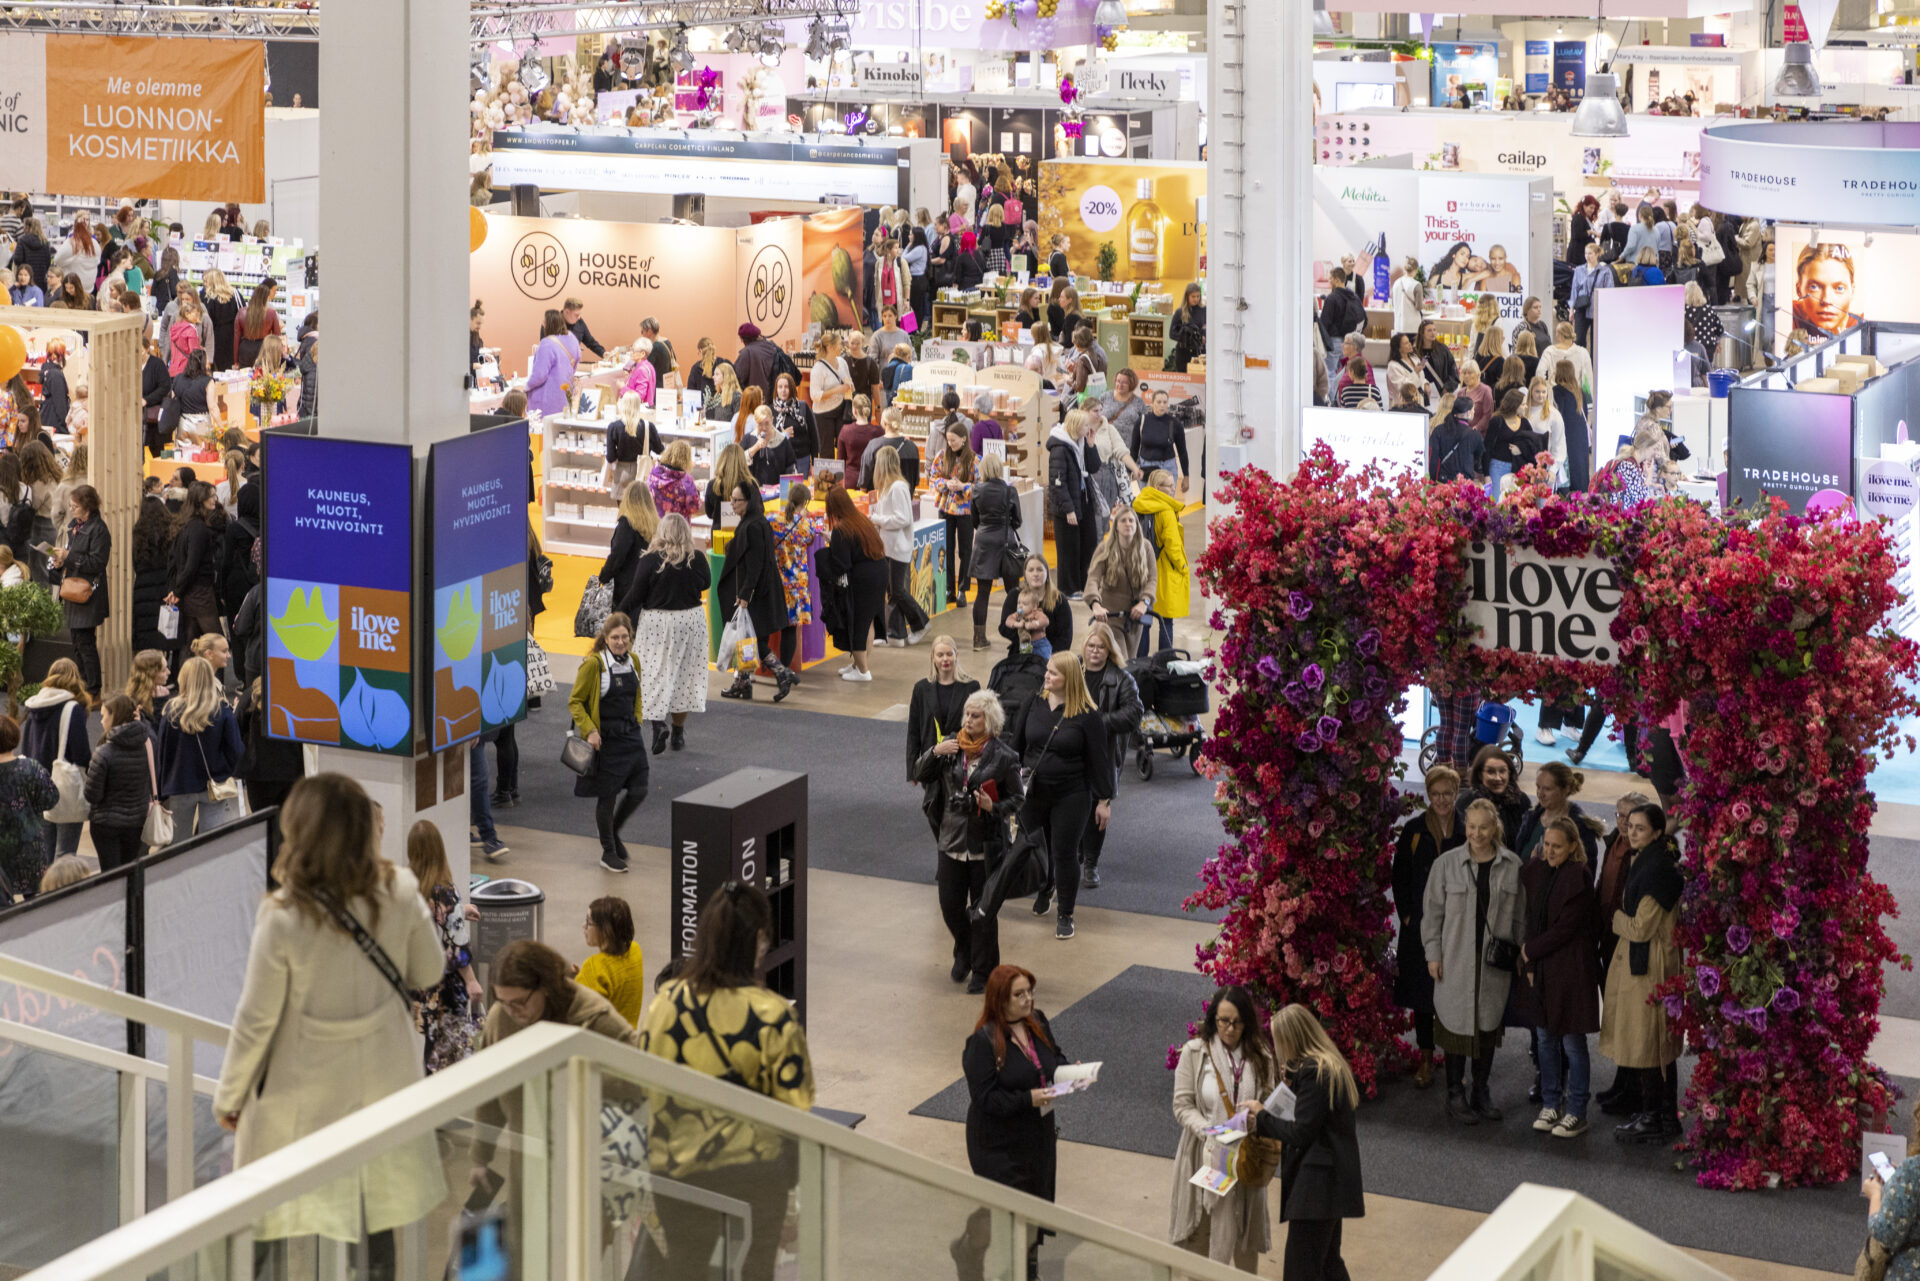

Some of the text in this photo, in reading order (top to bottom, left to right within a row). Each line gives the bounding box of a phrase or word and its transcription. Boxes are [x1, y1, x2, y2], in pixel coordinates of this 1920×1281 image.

[843, 0, 972, 32] wistbe
[863, 67, 920, 82] Kinoko
[106, 76, 202, 97] Me olemme
[4, 91, 22, 112] of
[83, 103, 223, 133] LUONNON-
[69, 132, 241, 165] KOSMETIIKKA
[634, 142, 735, 153] CARPELAN COSMETICS FINLAND
[1497, 150, 1547, 168] cailap
[1730, 169, 1797, 187] TRADEHOUSE
[1842, 179, 1920, 191] TRADEHOU
[1084, 201, 1118, 216] -20%
[1424, 215, 1460, 229] This is
[1424, 229, 1476, 243] your skin
[579, 252, 655, 273] HOUSE of
[578, 270, 661, 290] ORGANIC
[1508, 281, 1523, 294] be
[1496, 294, 1523, 307] roud
[1500, 305, 1512, 319] of
[924, 346, 939, 354] eco
[1742, 467, 1840, 486] TRADEHOUSE
[1893, 478, 1913, 488] me.
[307, 487, 371, 507] KAUNEUS,
[461, 478, 504, 499] KAUNEUS,
[1789, 484, 1819, 492] CURIOUS
[466, 494, 498, 511] MUOTI,
[1893, 496, 1913, 506] me.
[316, 503, 363, 521] MUOTI,
[452, 504, 512, 530] HYVINVOINTI
[294, 516, 384, 536] HYVINVOINTI
[493, 609, 518, 631] me.
[358, 630, 397, 653] me.
[1493, 606, 1611, 661] me.
[682, 840, 699, 958] FORMATION
